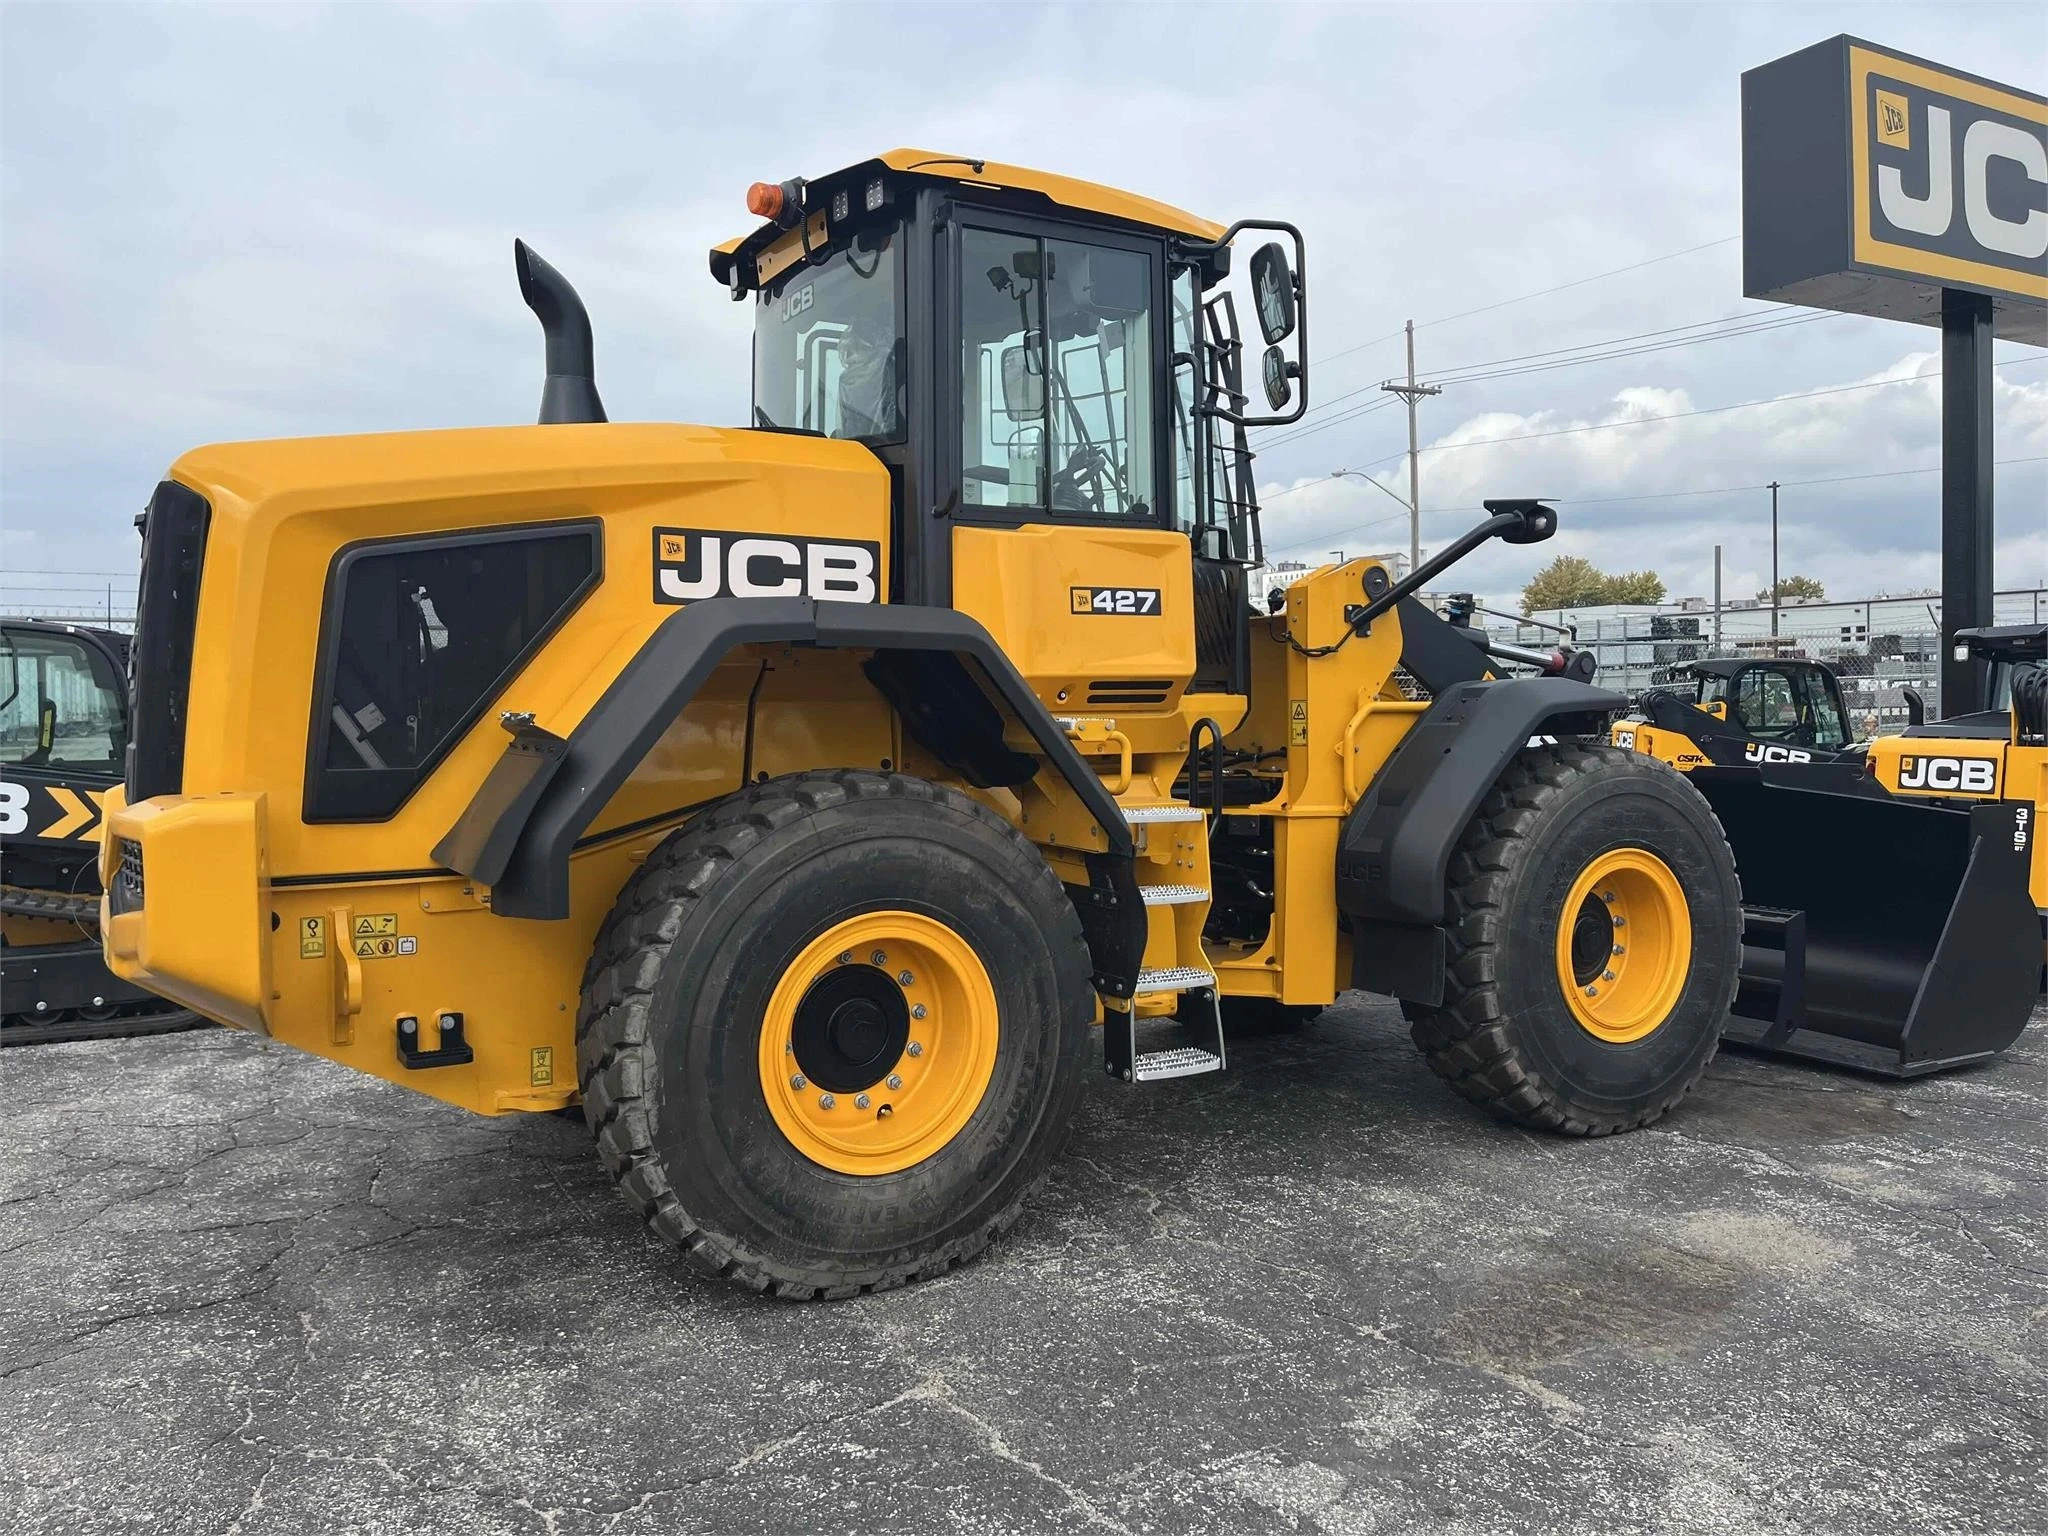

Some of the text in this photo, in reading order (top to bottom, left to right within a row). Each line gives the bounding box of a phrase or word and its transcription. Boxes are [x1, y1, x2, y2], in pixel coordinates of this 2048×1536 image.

[782, 284, 813, 322] JCB
[660, 536, 875, 604] JCB
[1092, 590, 1156, 613] 427
[1616, 731, 1634, 749] JCB
[1745, 744, 1811, 763] JCB
[1900, 758, 1994, 791] JCB
